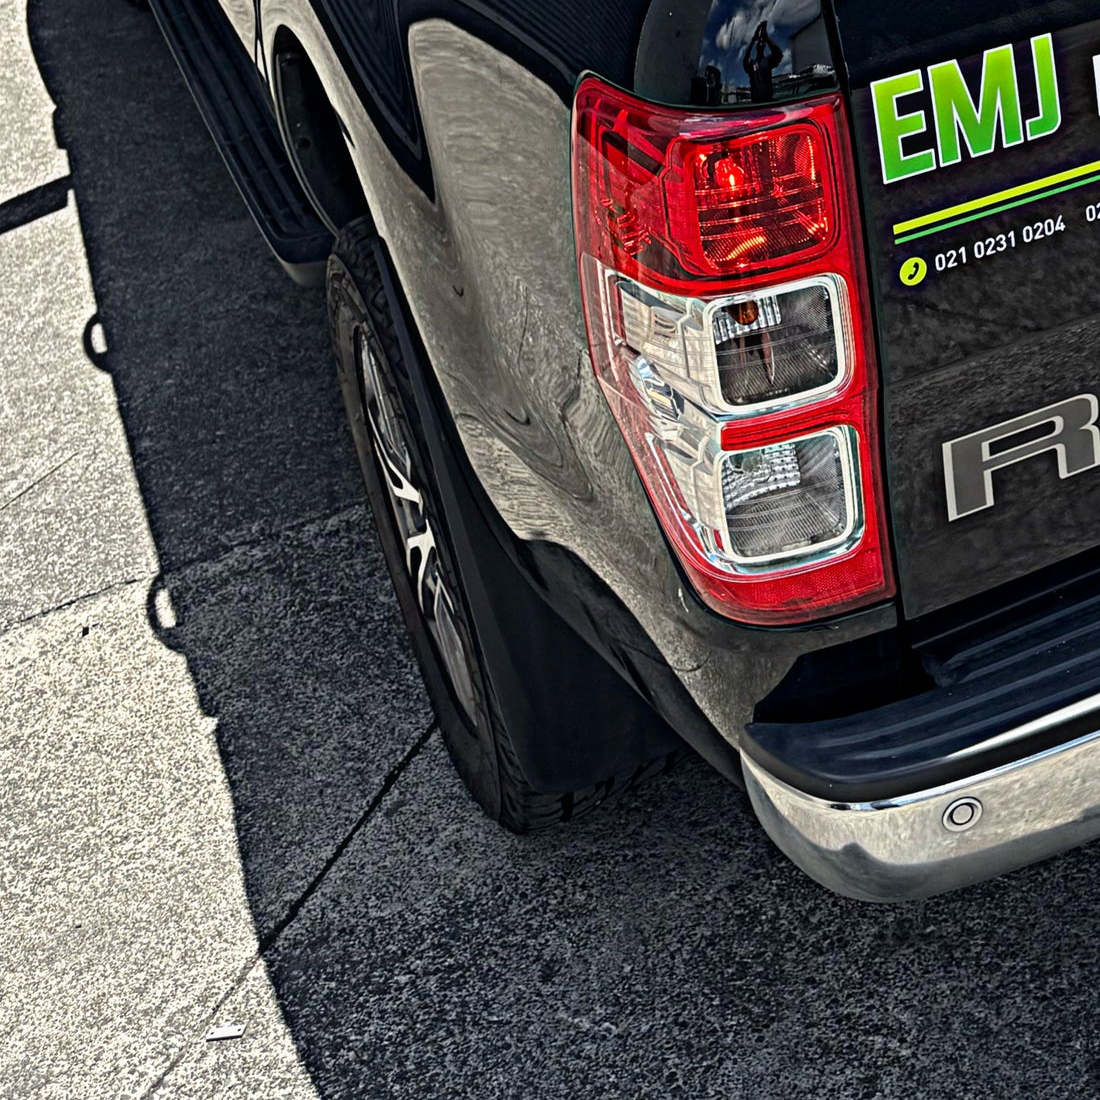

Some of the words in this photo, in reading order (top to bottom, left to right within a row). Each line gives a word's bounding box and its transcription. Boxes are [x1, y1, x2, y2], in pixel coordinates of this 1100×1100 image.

[870, 33, 1061, 184] EMJ
[935, 248, 966, 271] 021
[974, 231, 1015, 259] 0231
[1022, 215, 1065, 243] 0204
